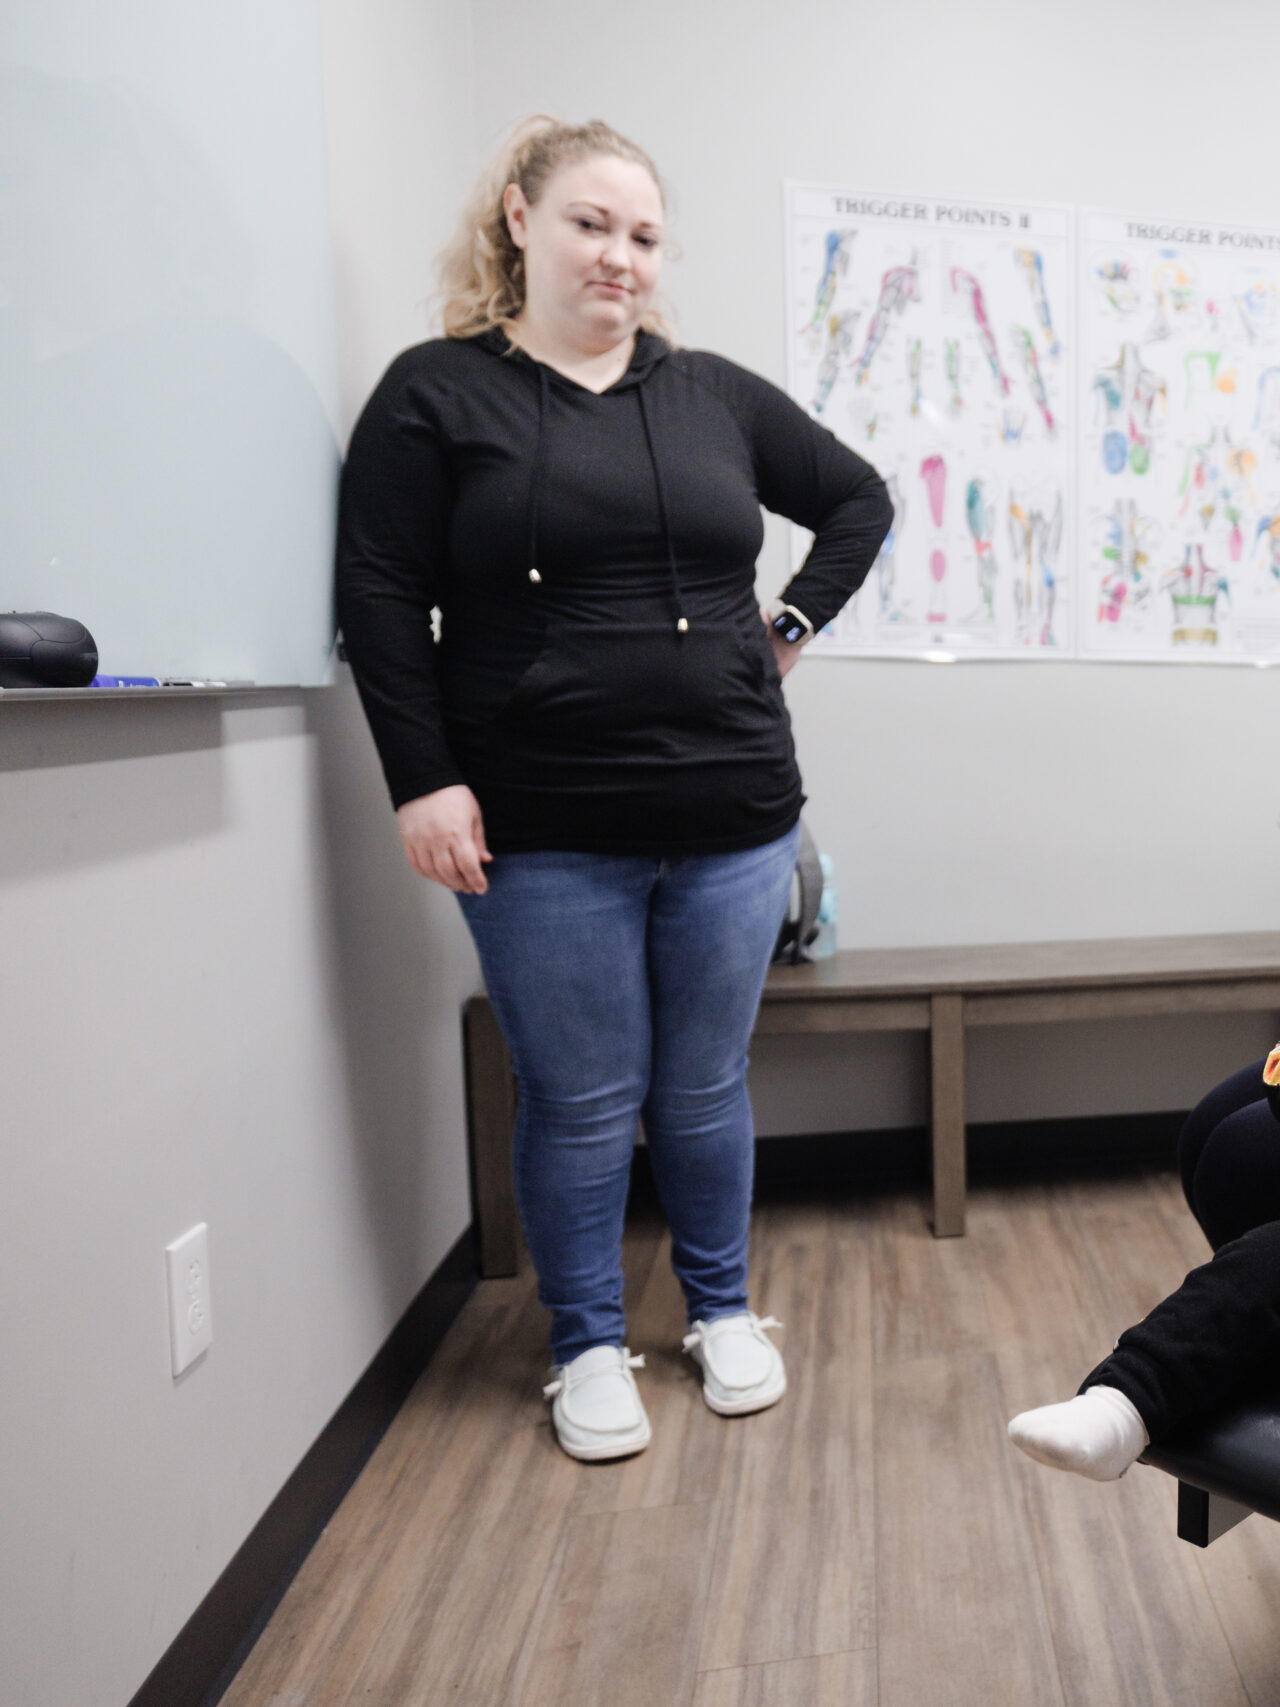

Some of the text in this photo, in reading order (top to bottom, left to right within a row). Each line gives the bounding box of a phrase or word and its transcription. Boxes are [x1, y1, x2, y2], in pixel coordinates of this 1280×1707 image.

[833, 196, 929, 220] TRIGGER
[935, 204, 1011, 227] POINTS
[1126, 222, 1211, 245] TRIGGER
